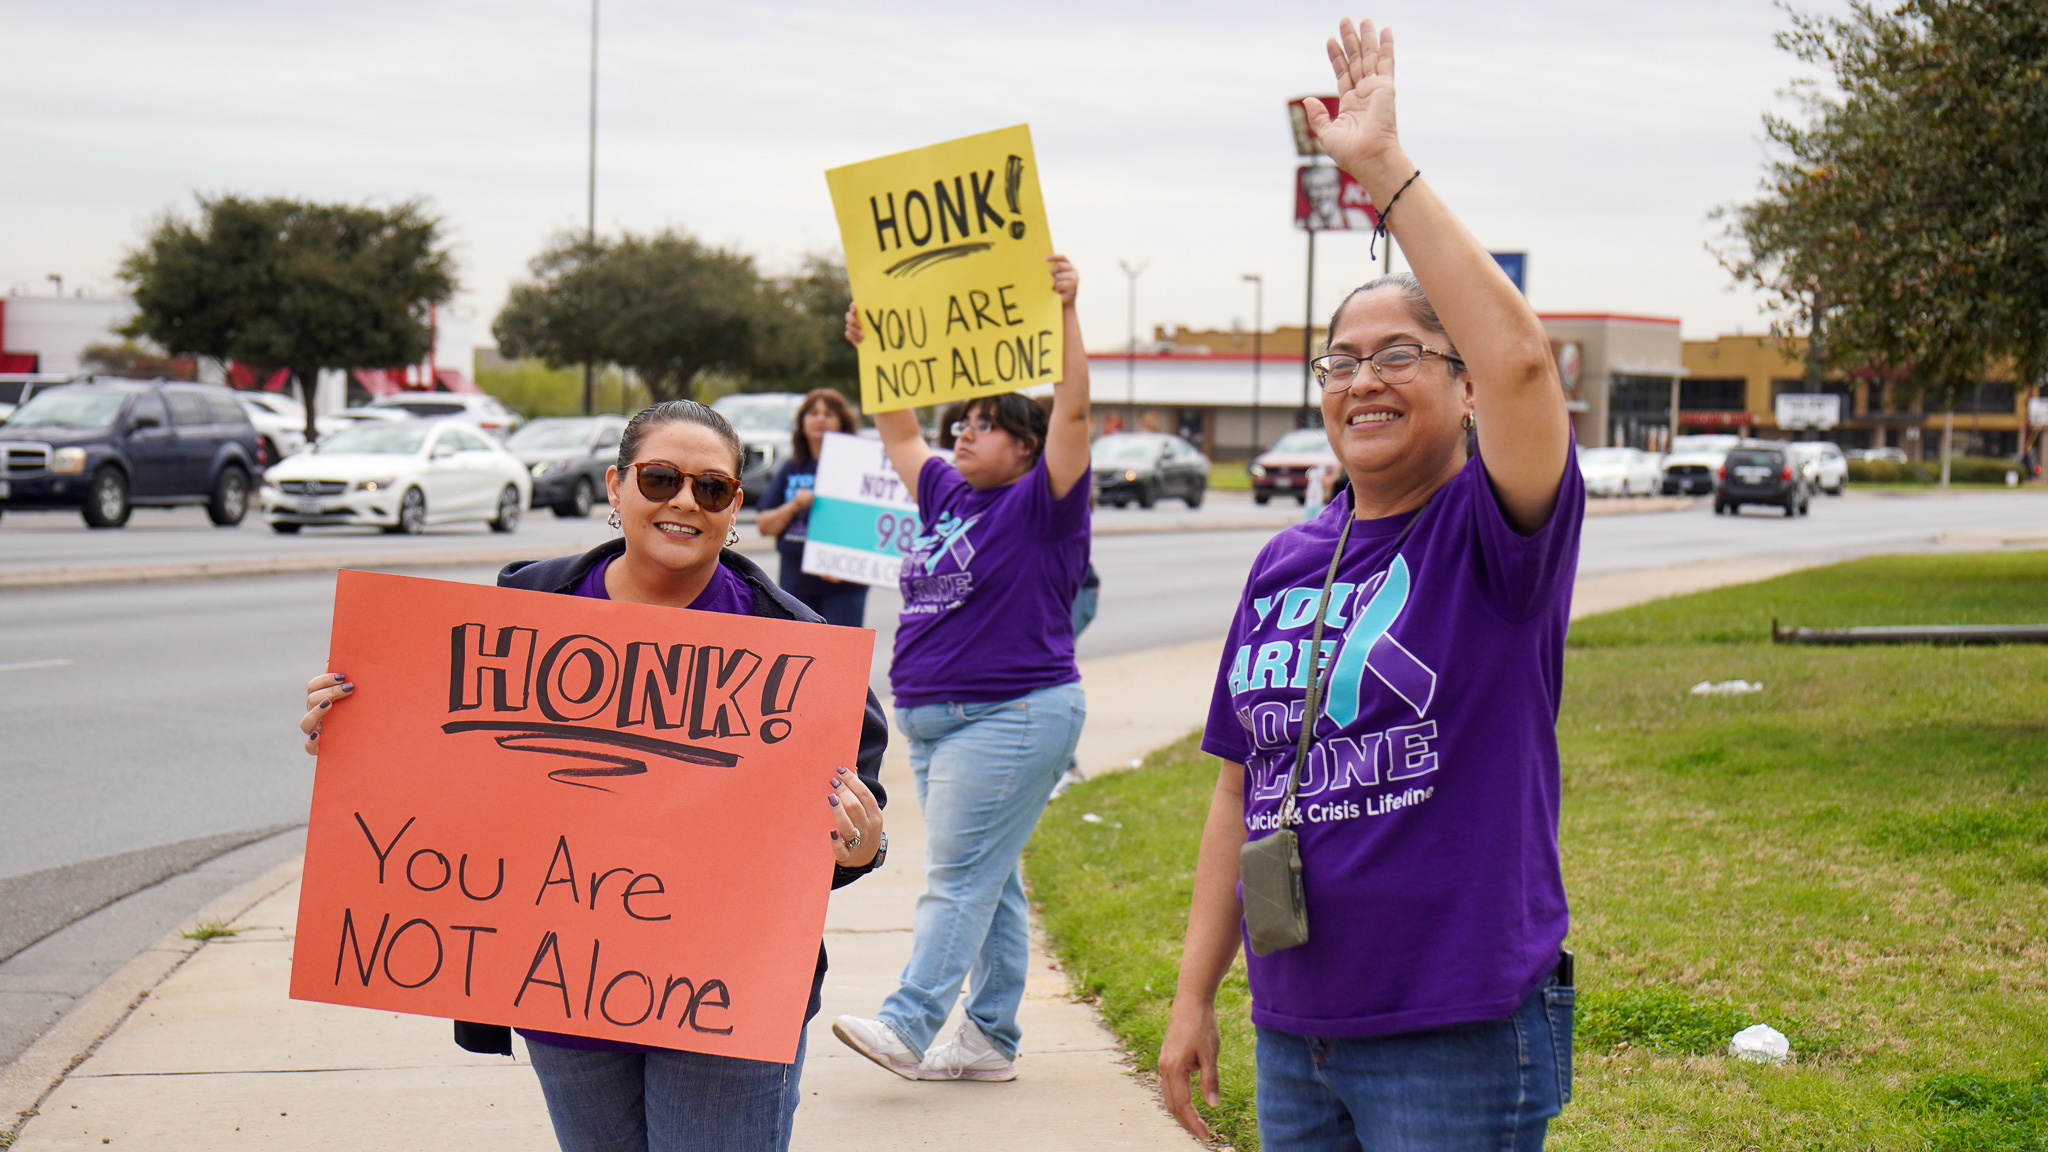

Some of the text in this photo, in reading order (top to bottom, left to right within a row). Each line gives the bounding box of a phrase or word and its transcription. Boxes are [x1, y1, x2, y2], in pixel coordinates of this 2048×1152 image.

[869, 154, 1026, 252] HONK!
[865, 284, 1024, 352] YOU ARE
[876, 330, 1053, 404] NOT ALONE
[860, 473, 900, 501] NOT
[448, 623, 816, 744] HONK!
[1228, 639, 1338, 697] ARE
[1307, 799, 1361, 823] Crisis
[1366, 785, 1435, 816] Lifeline
[353, 812, 671, 922] You Are
[334, 907, 734, 1036] NOT Alone
